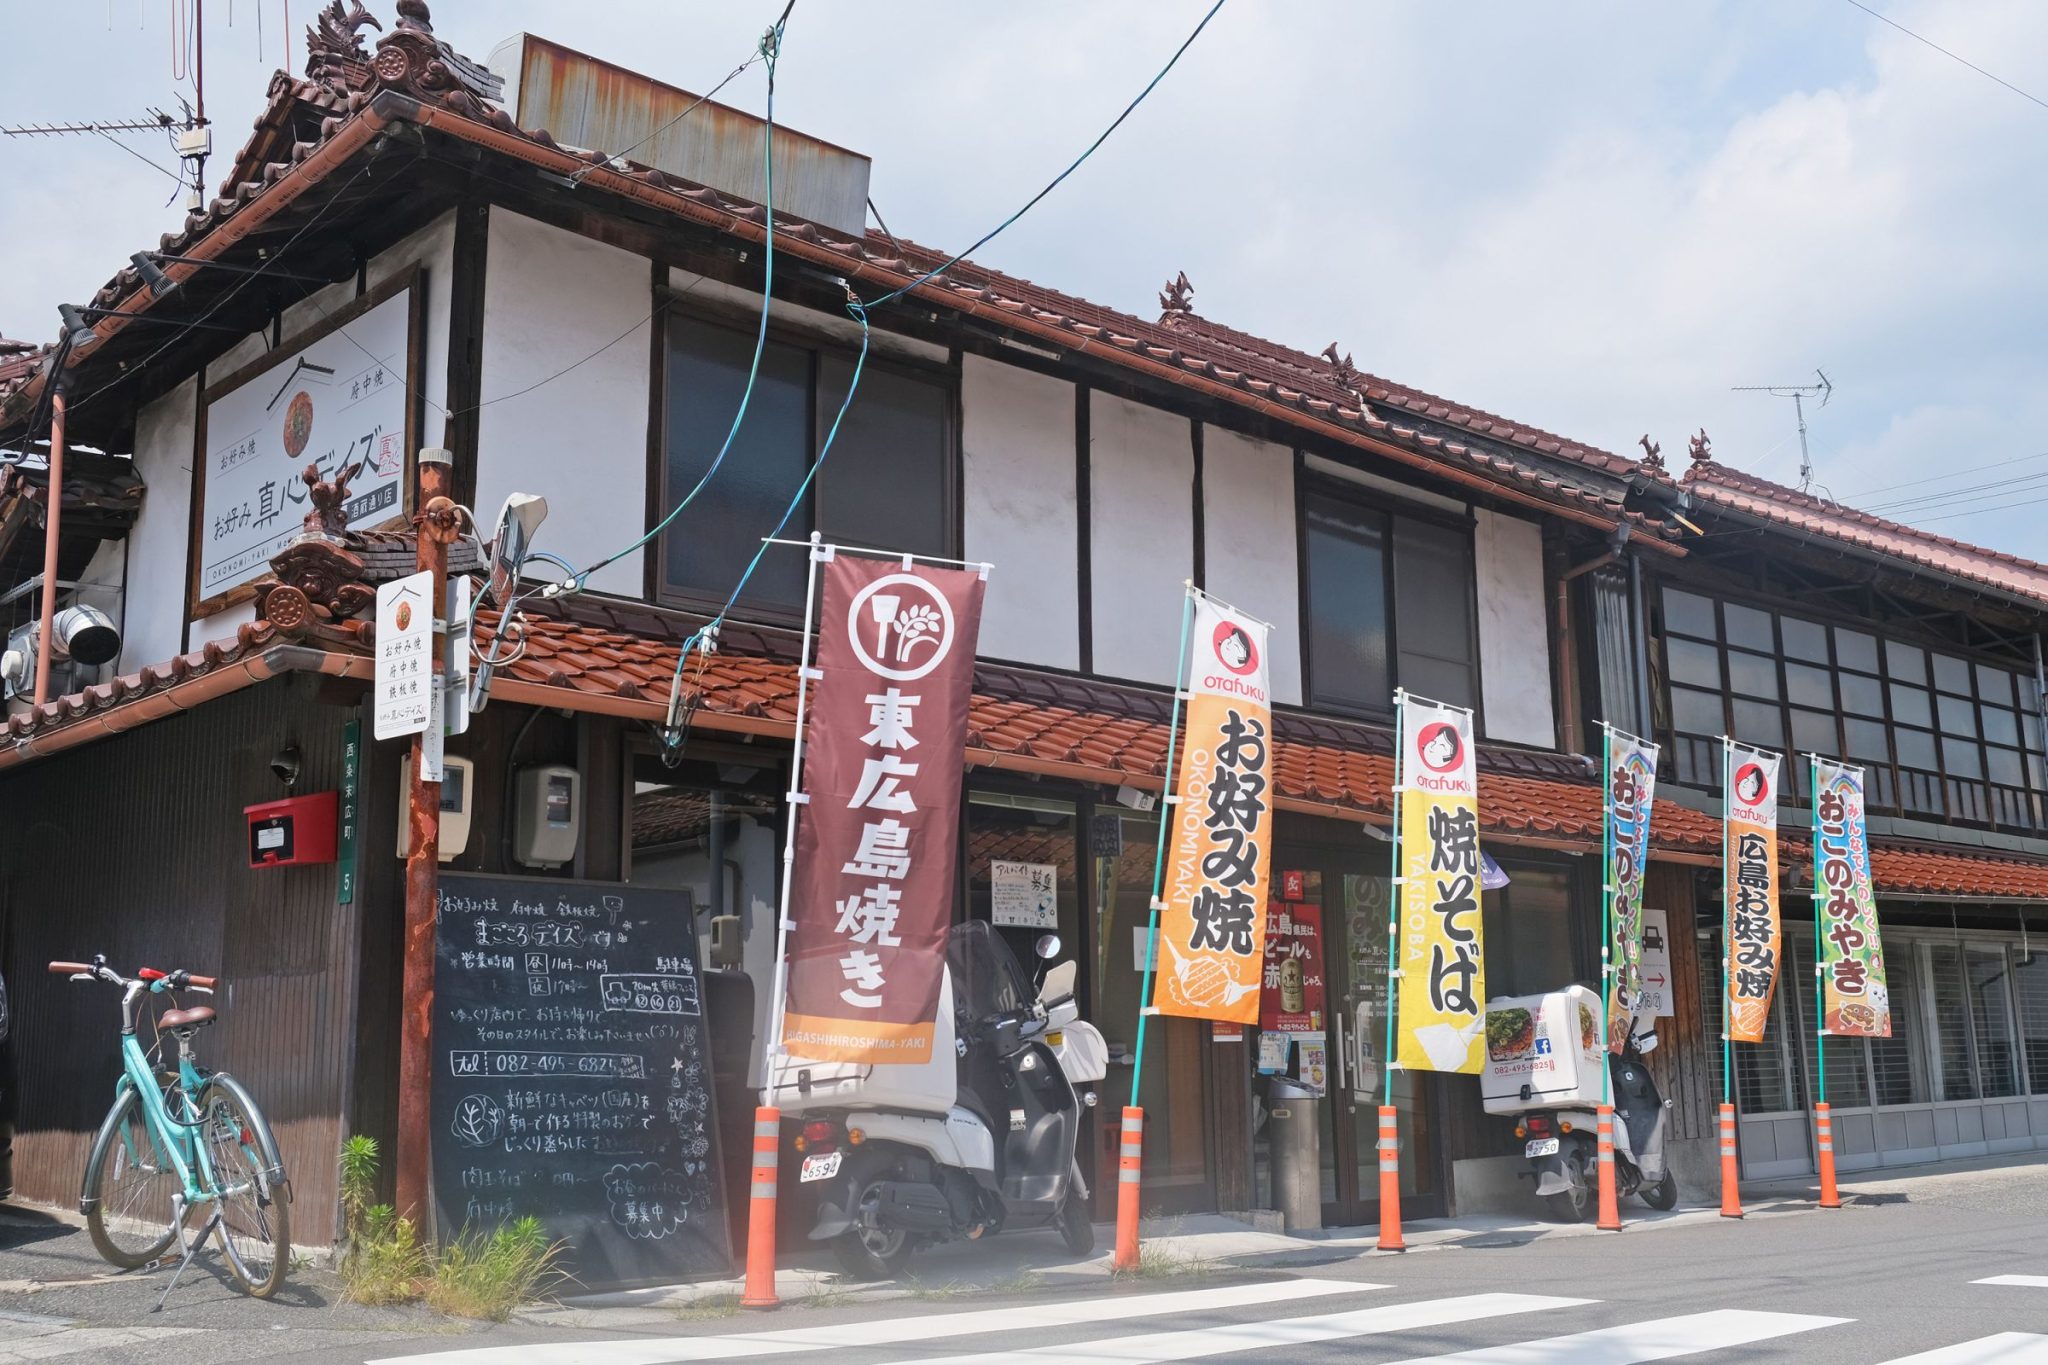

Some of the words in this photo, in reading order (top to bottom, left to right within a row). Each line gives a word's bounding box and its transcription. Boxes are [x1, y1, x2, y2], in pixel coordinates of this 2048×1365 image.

[219, 438, 257, 470] お好み焼
[350, 489, 393, 519] 酒蔵通り店
[212, 546, 270, 580] OKONOMI-YAKI
[385, 637, 422, 657] お好み焼
[389, 660, 418, 679] 府中焼
[344, 743, 356, 840] 西条末広町
[1172, 749, 1208, 904] OKONOMIYAKI
[1189, 709, 1267, 956] お好み焼
[833, 687, 923, 1008] 東広島焼き
[343, 873, 350, 891] 5
[1848, 802, 1879, 949] みんなでたのしく!!
[443, 896, 500, 913] お好み焼
[1407, 853, 1427, 961] YAKISOBA
[1818, 789, 1868, 995] おこのみやき
[1430, 805, 1480, 1017] 焼そば
[1733, 833, 1775, 999] 広島お好み焼
[477, 919, 530, 945] まごころ
[535, 922, 582, 945] デイズ
[593, 930, 611, 947] です
[461, 952, 514, 972] 営業時間
[1265, 938, 1312, 960] ビールも
[1264, 963, 1280, 990] 赤
[786, 1029, 926, 1050] HIGASHIHIROSHIMA-YAKI
[1494, 1062, 1549, 1074] 082-495-6825
[625, 1202, 664, 1223] 募集中
